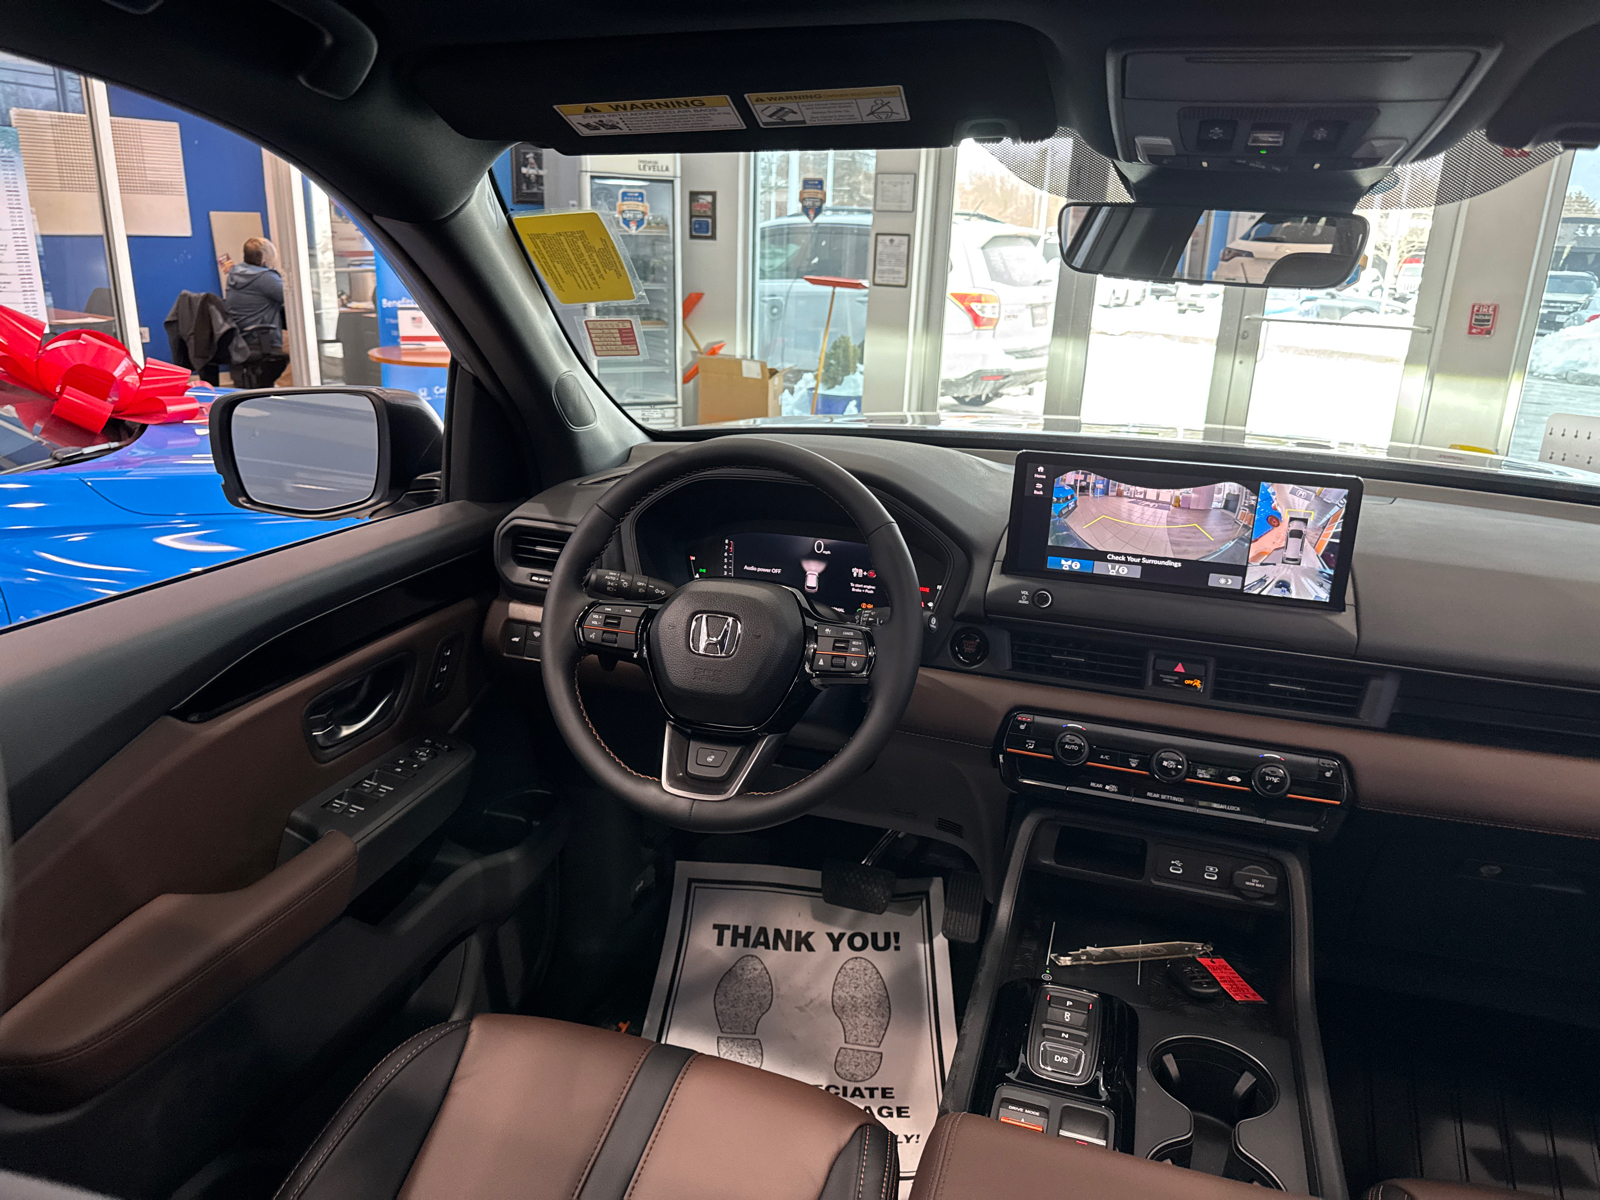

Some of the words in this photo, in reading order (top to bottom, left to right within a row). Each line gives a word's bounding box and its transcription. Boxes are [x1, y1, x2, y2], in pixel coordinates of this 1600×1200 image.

[608, 99, 706, 112] WARNING
[637, 164, 671, 173] LEVELLA
[1473, 305, 1495, 314] FIRE
[814, 540, 824, 554] 0
[1106, 553, 1126, 563] Check
[1126, 555, 1141, 564] Your
[1141, 558, 1182, 569] Surroundings
[743, 564, 757, 572] Audio
[1063, 744, 1080, 752] AUTO
[1264, 775, 1281, 784] SYNC
[1090, 781, 1104, 789] REAR
[1160, 794, 1185, 803] SETTINGS
[712, 923, 816, 953] THANK
[825, 931, 901, 953] YOU!
[1054, 1055, 1069, 1064] D/S
[811, 1084, 895, 1099] CIATE
[1008, 1105, 1024, 1113] DRIVE
[1024, 1109, 1040, 1117] MODE
